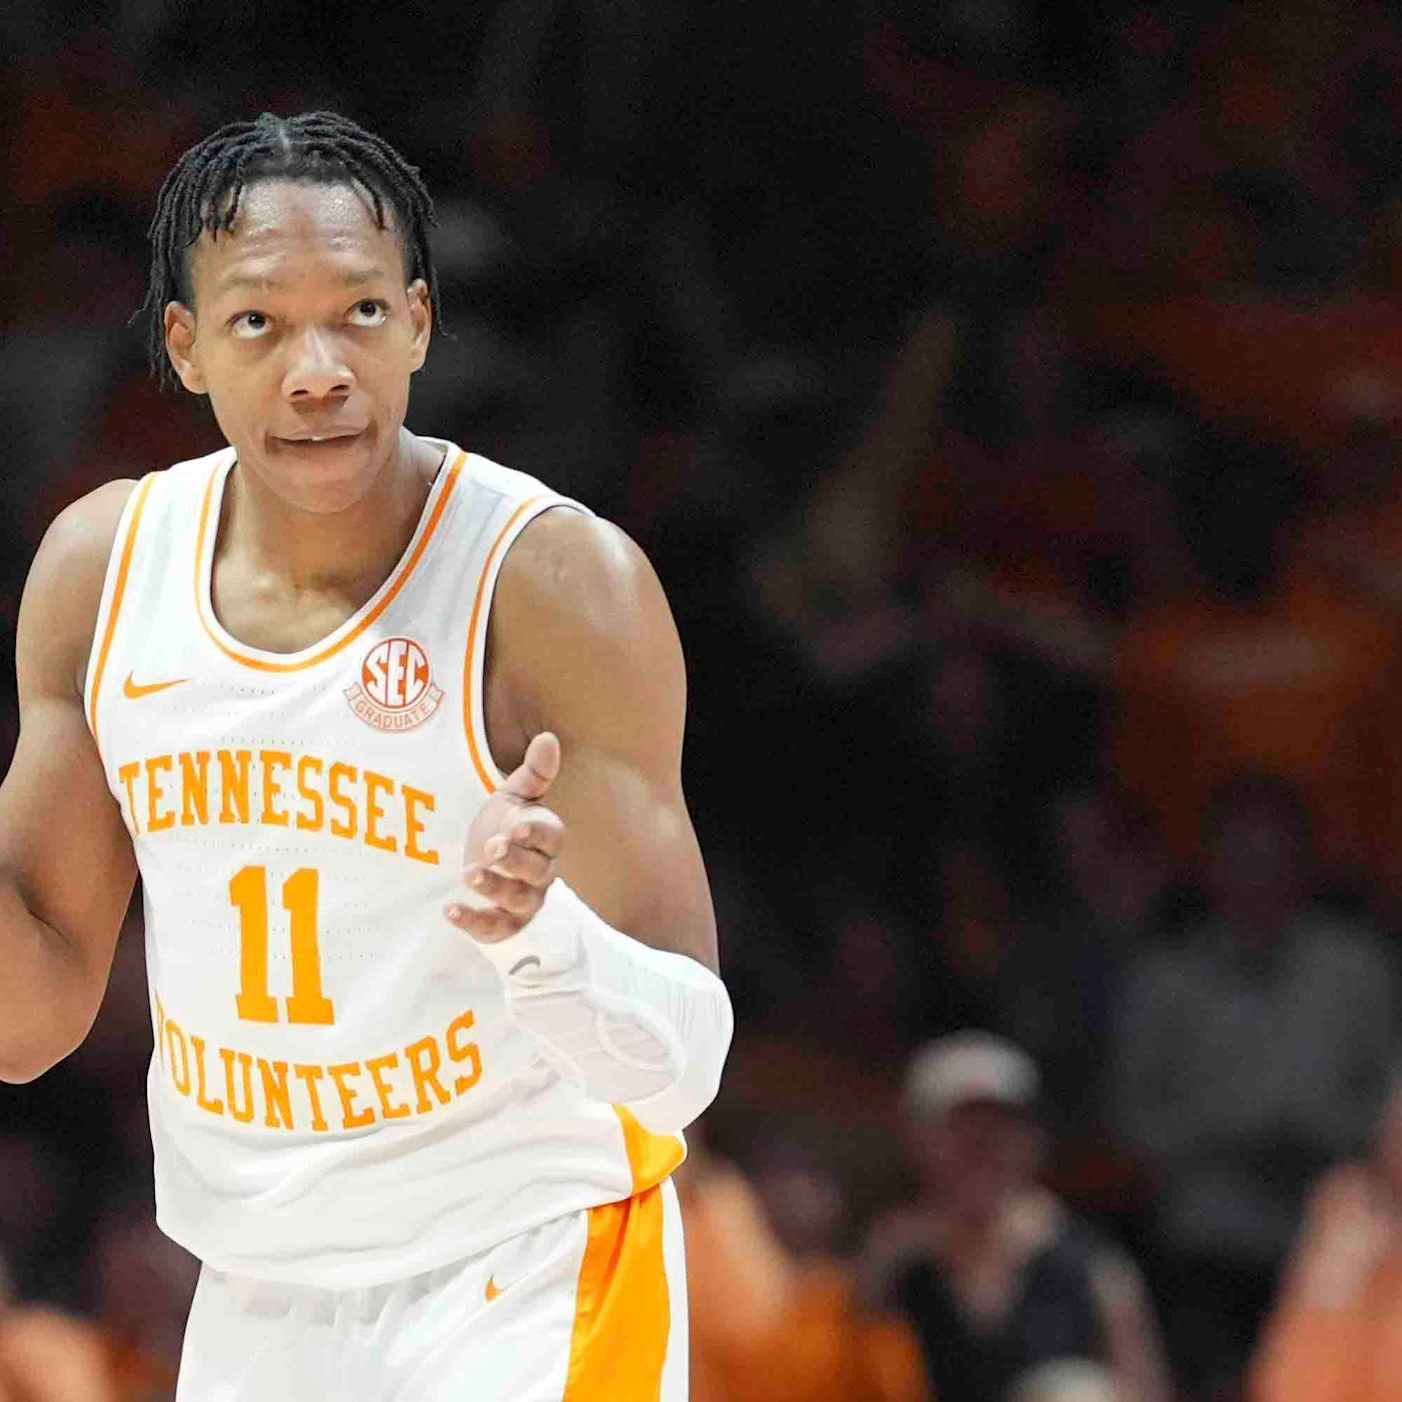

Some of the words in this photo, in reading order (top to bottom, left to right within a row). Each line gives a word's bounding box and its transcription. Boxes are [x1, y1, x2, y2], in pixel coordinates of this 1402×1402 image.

[363, 639, 427, 707] SEC
[119, 750, 439, 864] TENNESSEE
[229, 865, 334, 1024] 11
